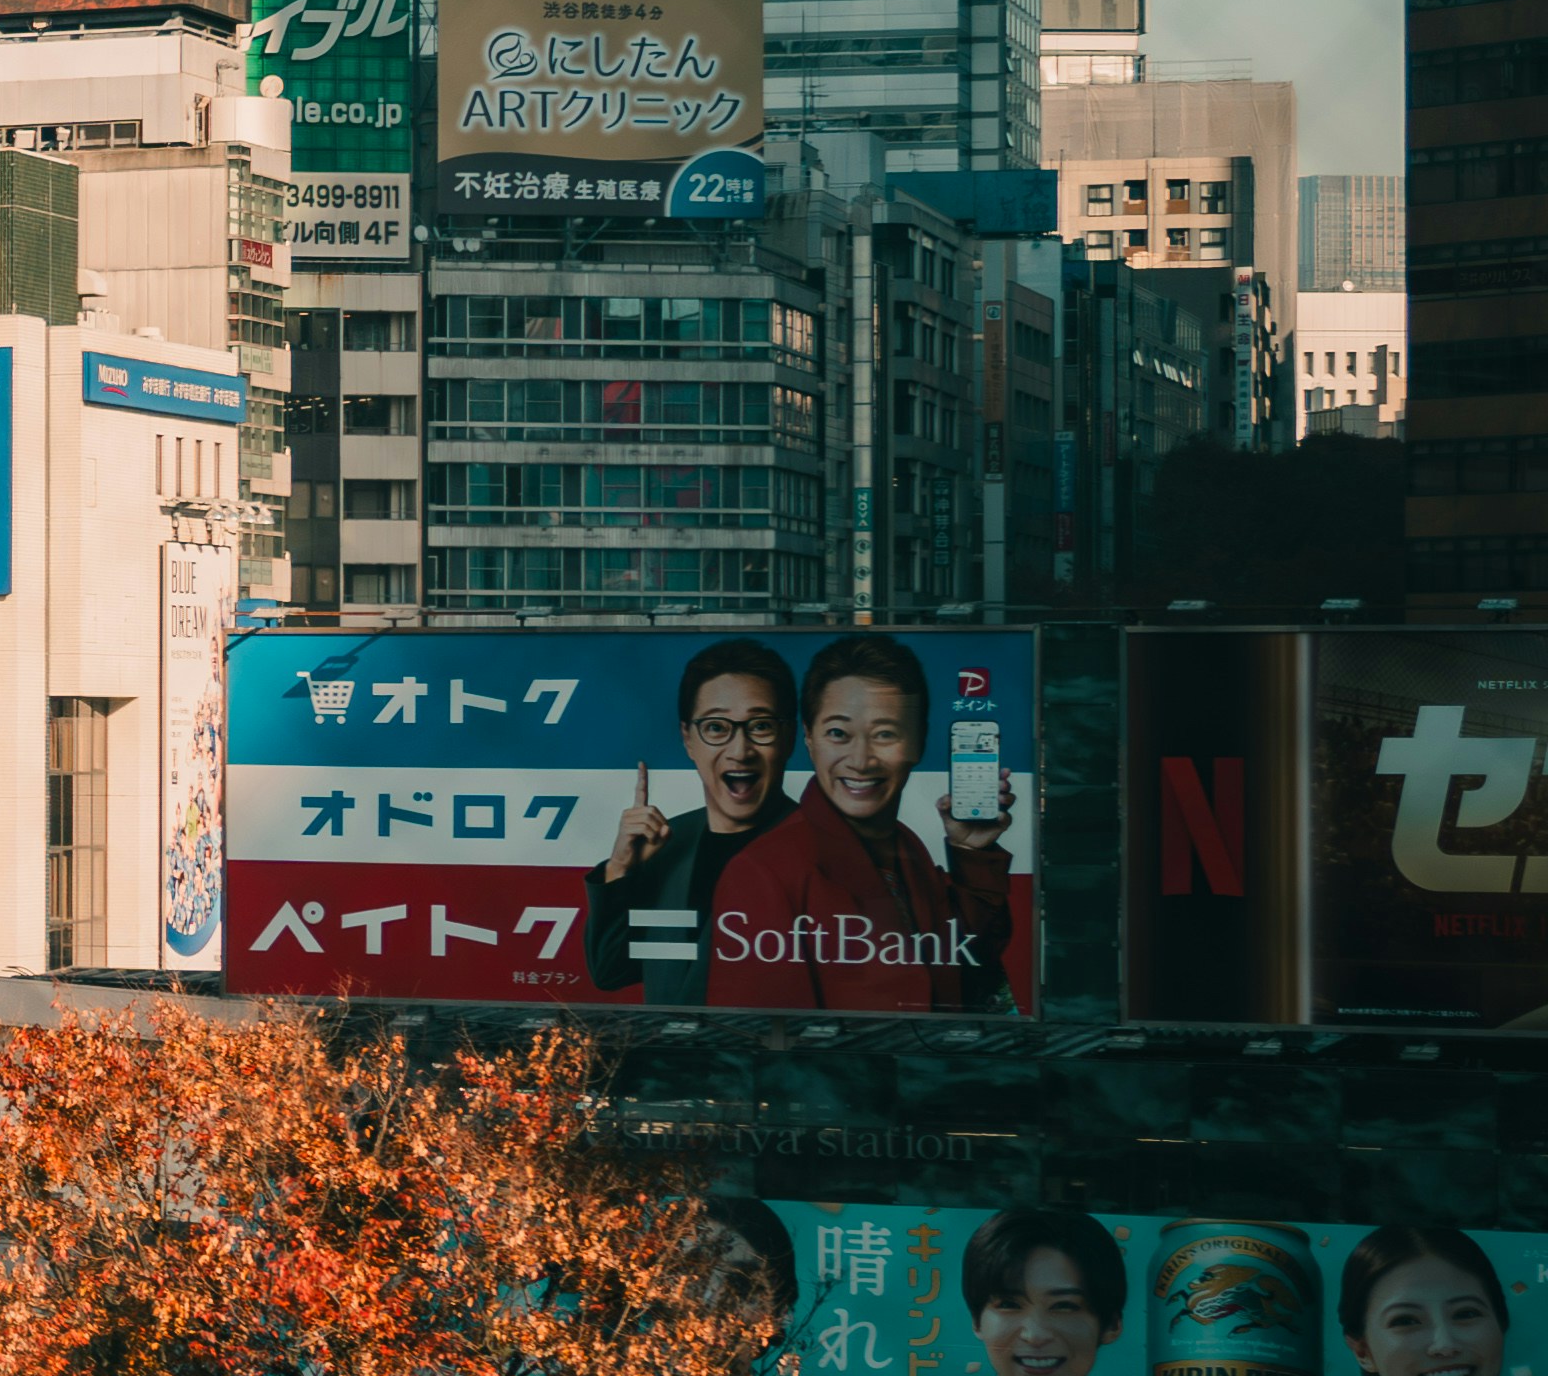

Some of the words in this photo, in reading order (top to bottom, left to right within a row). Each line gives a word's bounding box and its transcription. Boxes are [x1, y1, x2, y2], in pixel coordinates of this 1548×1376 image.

[543, 1, 663, 21] 渋谷院徒歩4分
[549, 34, 715, 79] にしたん
[292, 96, 403, 128] le.co.jp
[462, 89, 742, 132] ARTクリニック
[286, 184, 400, 209] 3499-8911
[455, 172, 569, 201] 不妊治療
[574, 179, 660, 202] 生殖医療
[98, 364, 128, 386] MIZUHO
[171, 560, 197, 595] BLUE
[171, 605, 207, 639] DREAM
[373, 677, 579, 725] オトク
[1477, 680, 1537, 690] NETFLIX
[952, 700, 997, 712] ポイント
[301, 790, 579, 842] オドロク
[1160, 757, 1245, 897] N
[249, 900, 581, 961] ペイトク
[716, 909, 981, 969] SoftBank
[512, 971, 581, 985] 料金プラン
[817, 1125, 974, 1162] station
